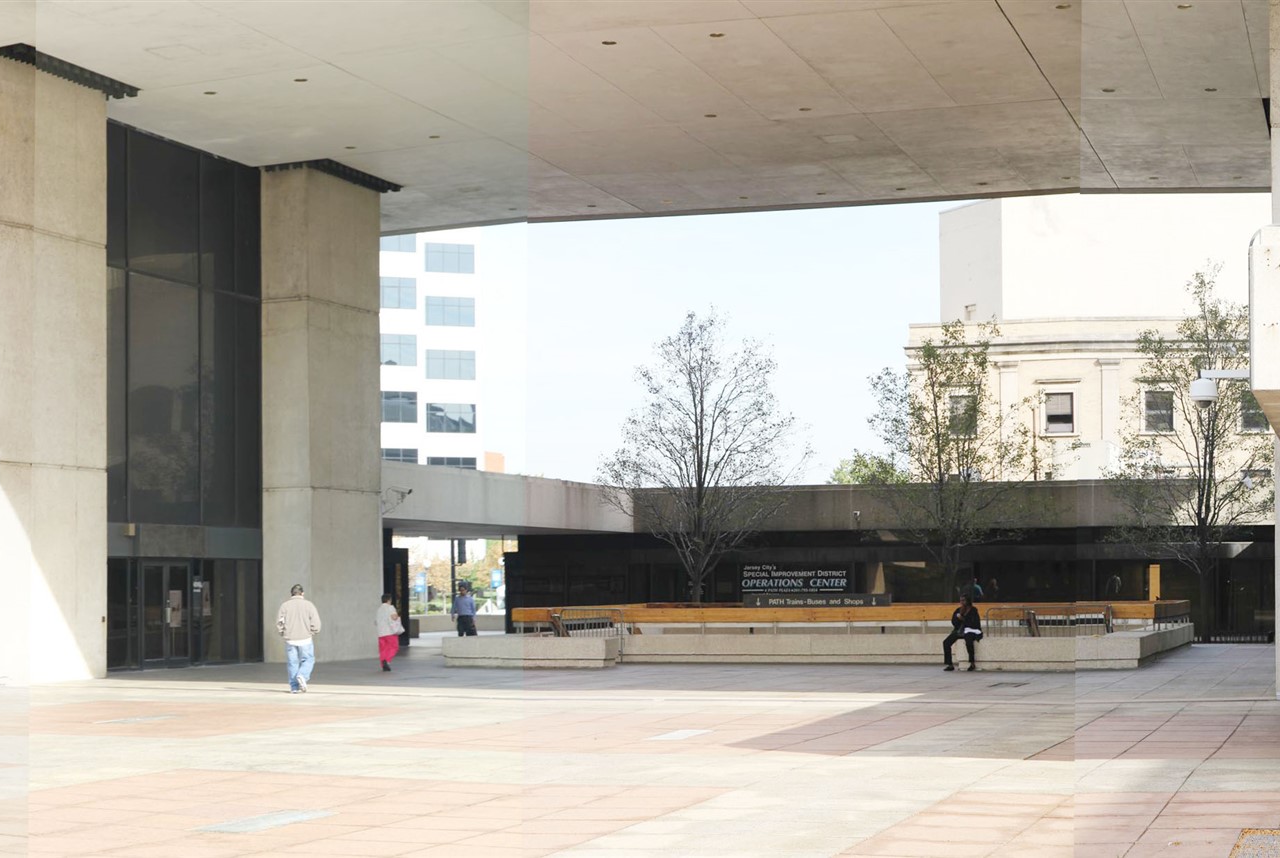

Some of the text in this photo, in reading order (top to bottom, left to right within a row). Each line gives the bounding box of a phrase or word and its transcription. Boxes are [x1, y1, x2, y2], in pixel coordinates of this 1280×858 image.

[743, 570, 770, 578] SPECIAL
[817, 569, 847, 577] DISTRICT
[741, 578, 848, 588] OPERATIONS CENTER
[843, 598, 864, 606] Shops
